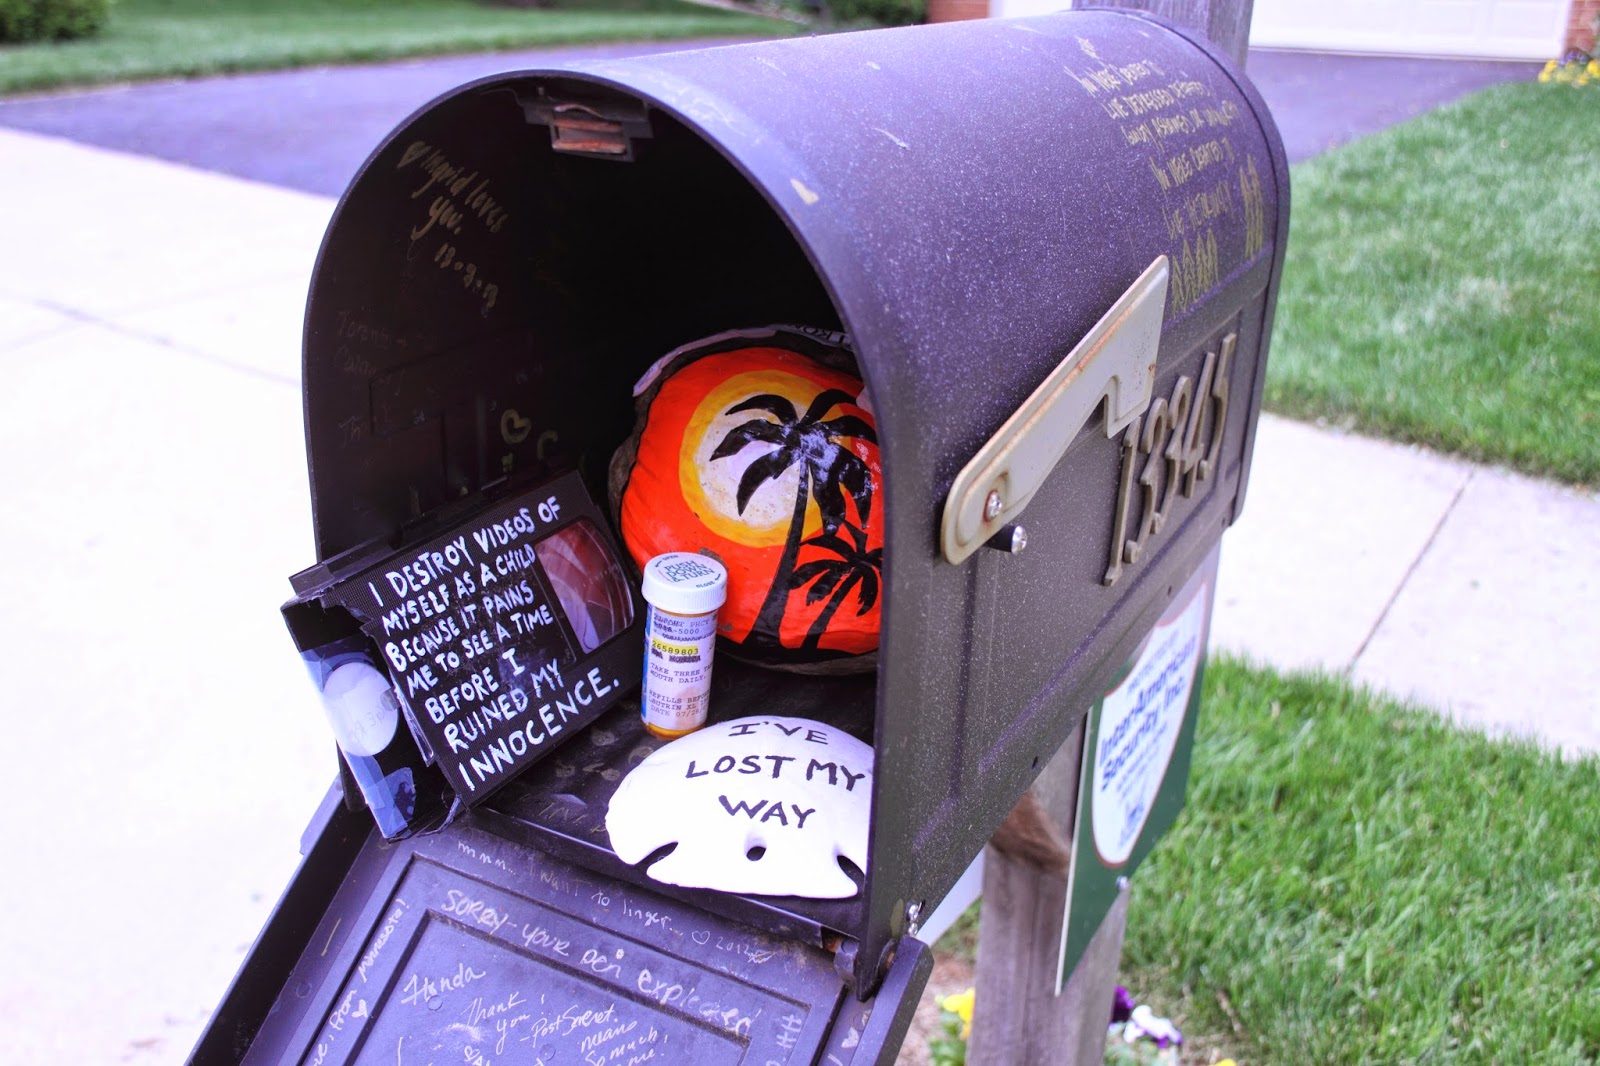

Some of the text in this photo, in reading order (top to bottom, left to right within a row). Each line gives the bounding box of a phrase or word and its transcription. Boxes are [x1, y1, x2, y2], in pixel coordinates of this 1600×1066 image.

[1103, 333, 1237, 586] 13345
[368, 496, 561, 607] I DESTROY VIDEOS OF
[664, 560, 699, 572] PUSH
[666, 563, 708, 578] DOWN
[681, 568, 715, 580] TURN
[381, 543, 536, 636] MYSELF AS A CHILD
[385, 579, 535, 672] BECAUSE IT PAINS
[406, 604, 554, 698] ME TO SEE A TIME
[652, 640, 699, 656] 26589803
[425, 648, 526, 724] BEFORE I
[650, 670, 673, 682] MOUTH
[651, 662, 669, 675] TAKE
[674, 669, 700, 677] THREE
[443, 687, 529, 754] RUINED
[531, 658, 565, 698] MY
[651, 705, 670, 717] DATE
[458, 667, 620, 791] INNOCENCE.
[728, 721, 829, 745] I'VE
[685, 755, 866, 792] LOST MY
[718, 794, 816, 829] WAY
[460, 991, 527, 1027] Thank
